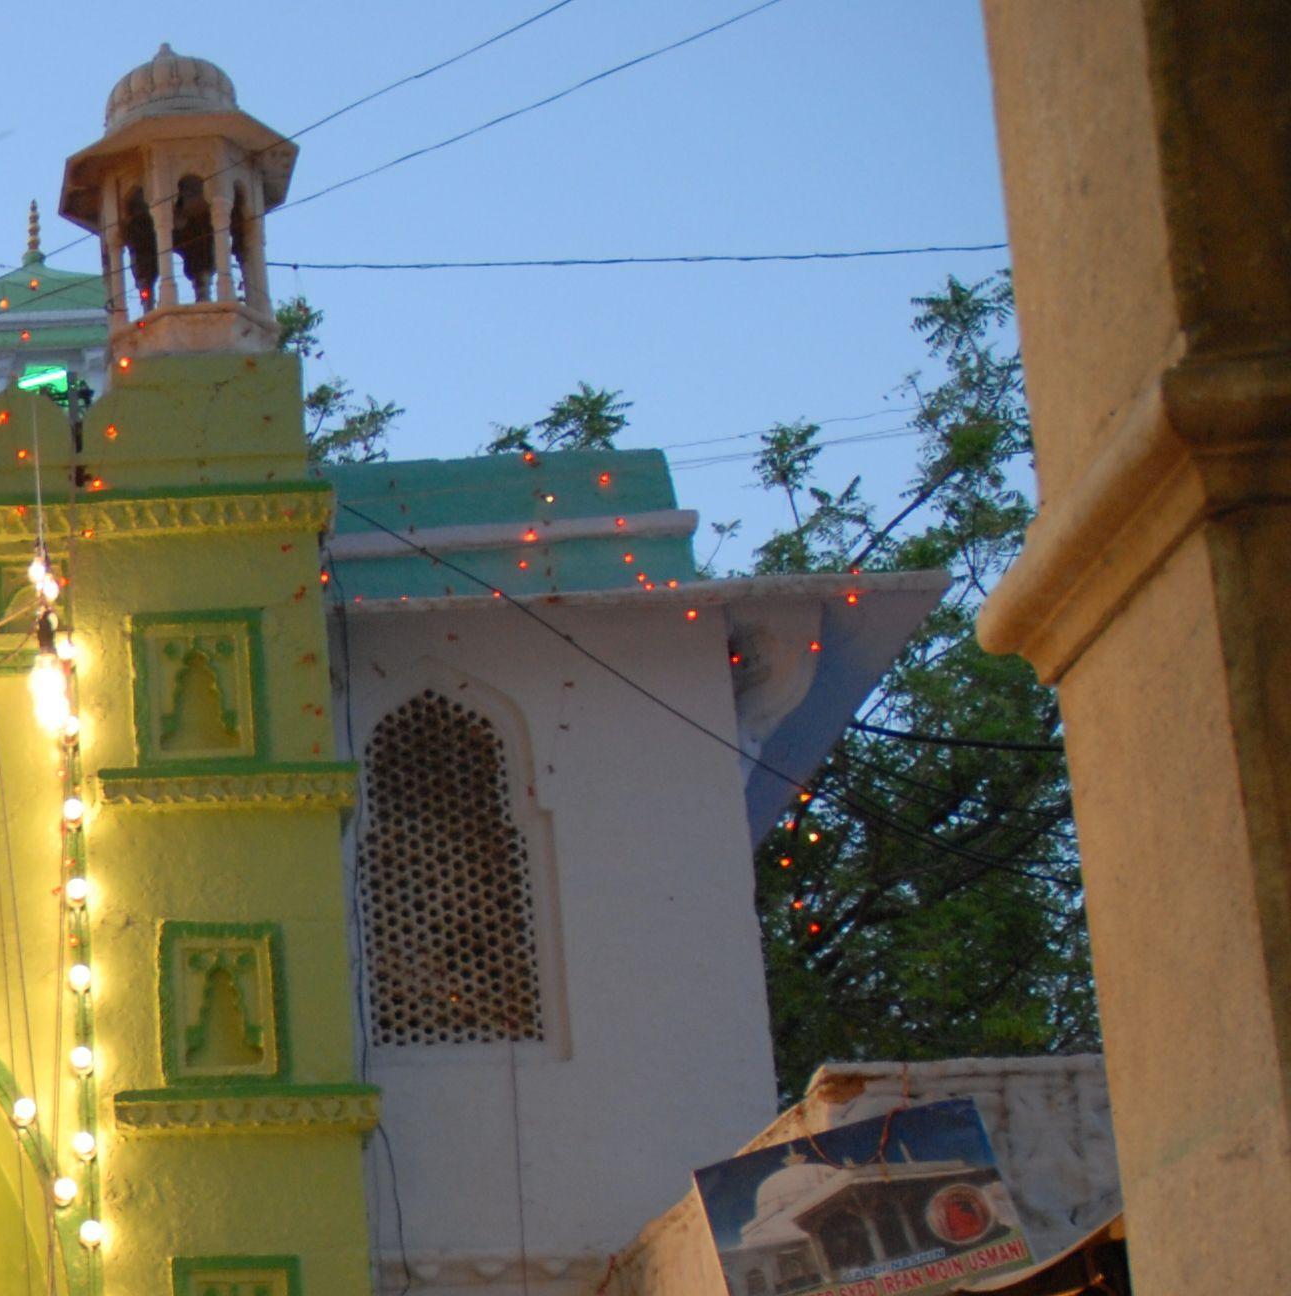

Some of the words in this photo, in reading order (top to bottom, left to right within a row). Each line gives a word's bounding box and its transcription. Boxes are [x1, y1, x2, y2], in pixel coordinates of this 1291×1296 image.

[881, 1271, 924, 1296] IRFAN
[925, 1258, 965, 1283] MOIN
[970, 1238, 1028, 1272] USMANI
